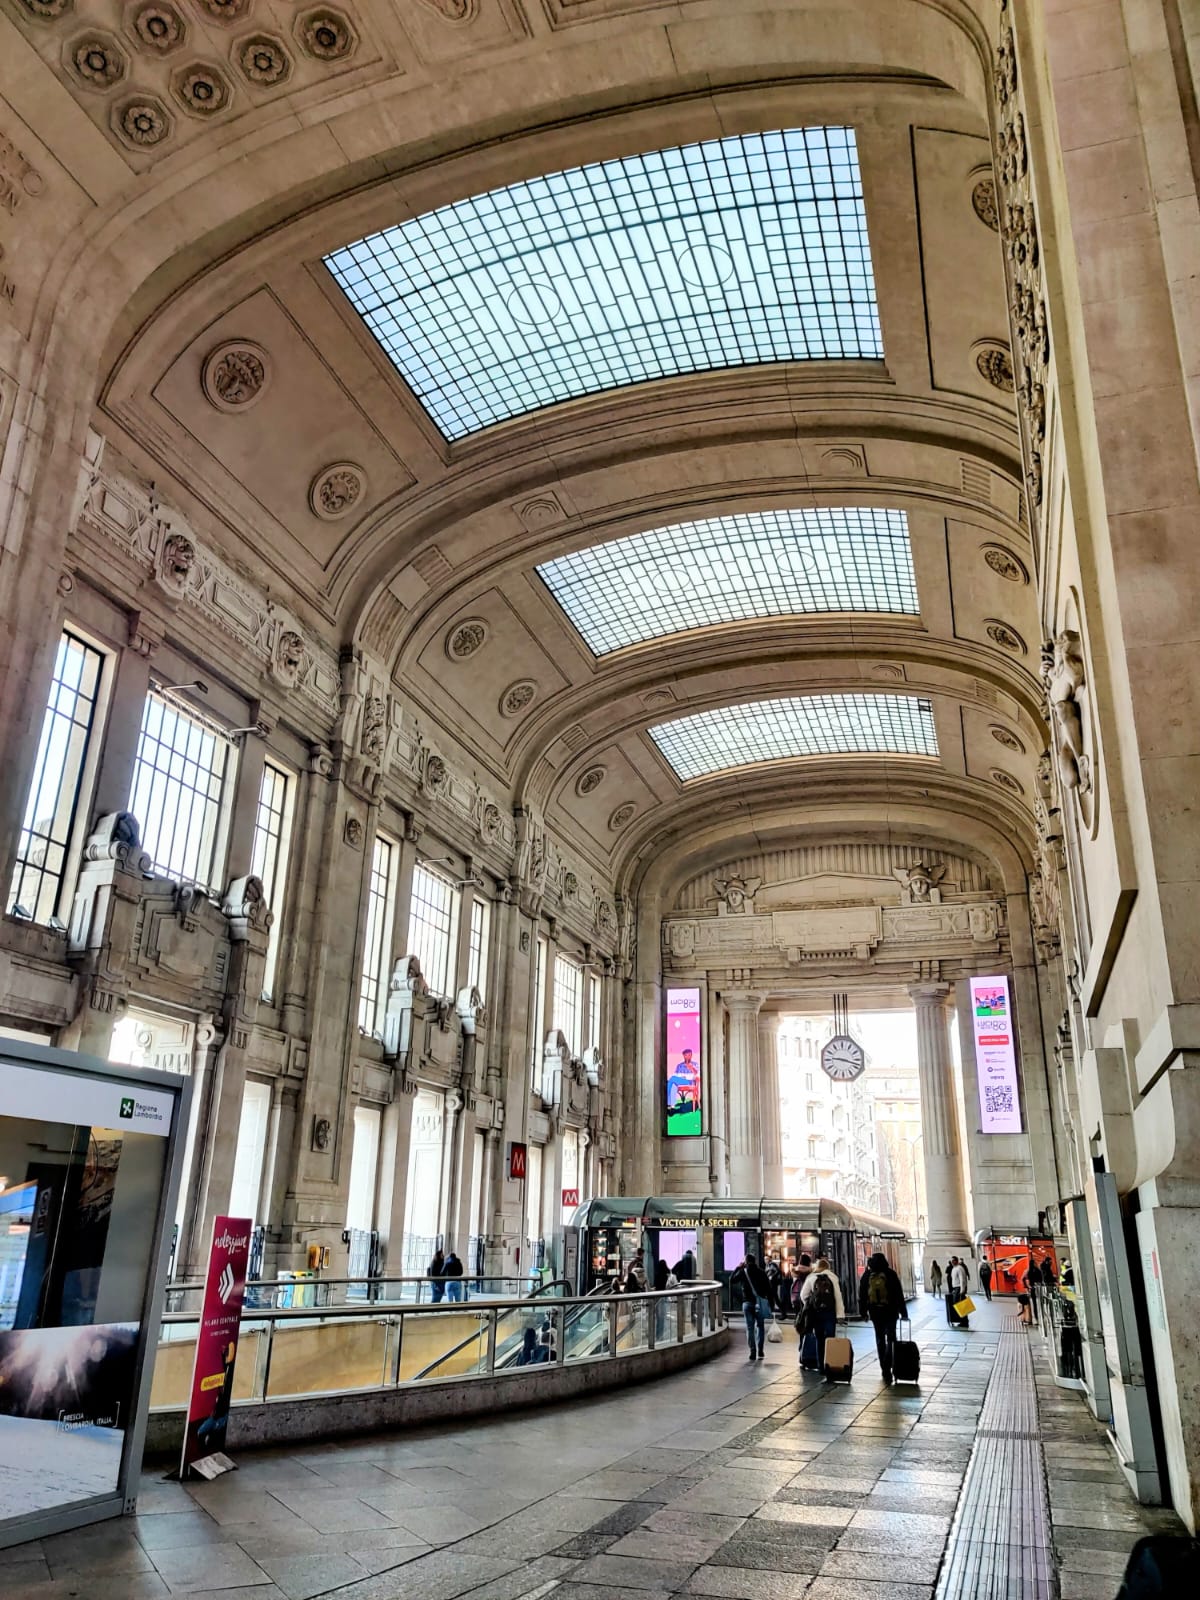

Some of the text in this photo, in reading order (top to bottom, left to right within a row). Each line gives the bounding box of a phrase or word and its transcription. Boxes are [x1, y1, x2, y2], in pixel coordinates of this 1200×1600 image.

[135, 1102, 158, 1112] Regione
[134, 1110, 163, 1120] Lombardia
[512, 1151, 525, 1171] M
[564, 1191, 578, 1204] M
[659, 1218, 738, 1227] VICTORIAS SECRET
